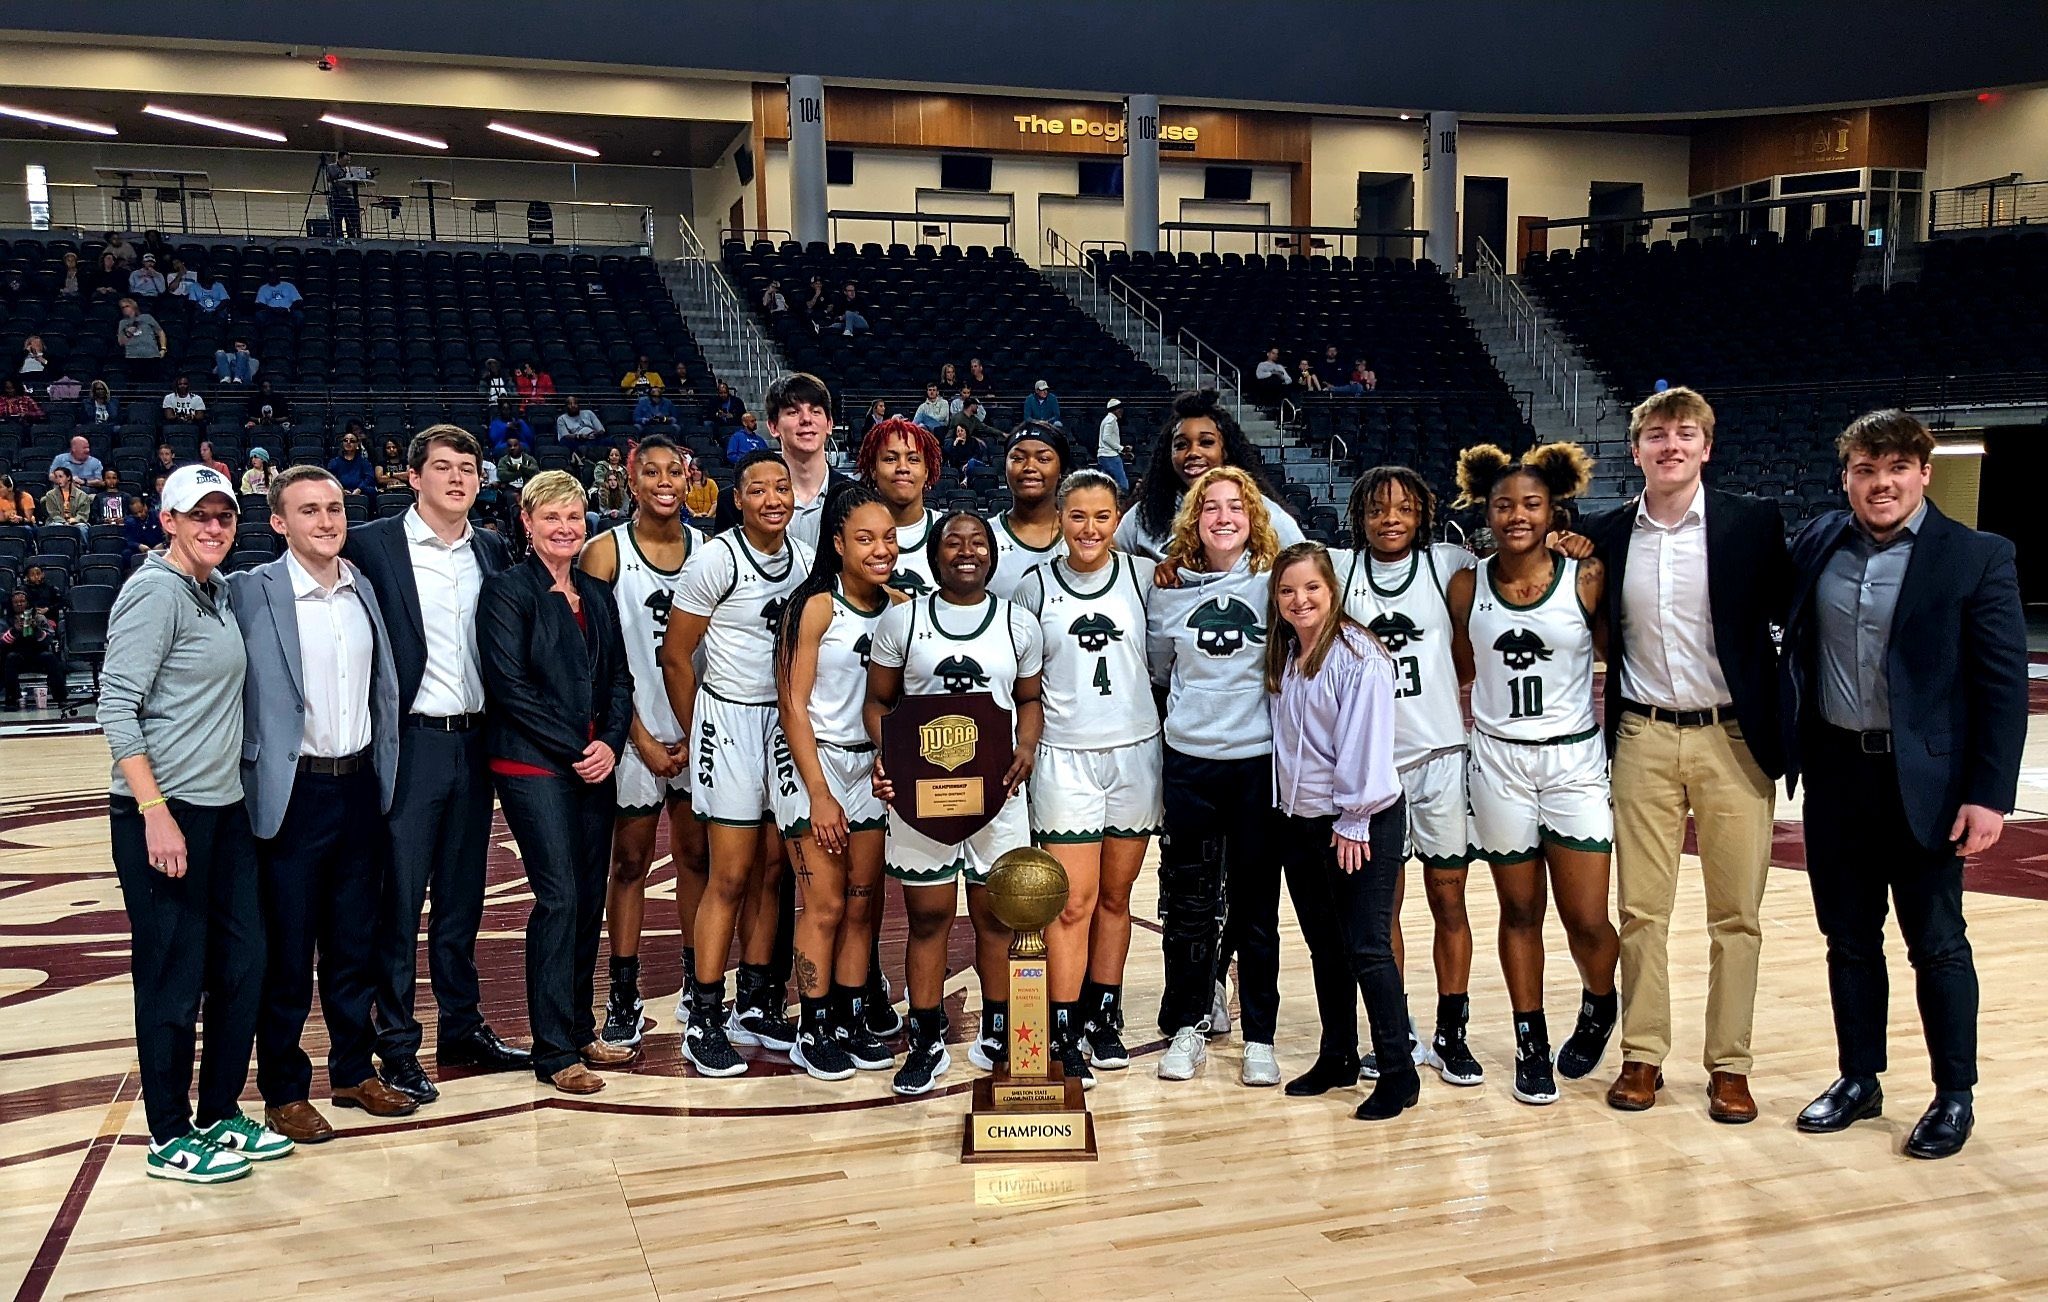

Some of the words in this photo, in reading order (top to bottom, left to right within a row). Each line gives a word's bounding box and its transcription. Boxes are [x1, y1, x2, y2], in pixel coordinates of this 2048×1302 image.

[799, 98, 820, 123] 104
[1014, 115, 1064, 134] The
[1071, 119, 1198, 141] Doguse
[1138, 116, 1157, 140] 105
[1093, 656, 1111, 695] 4
[1508, 675, 1543, 718] 10
[922, 724, 977, 755] NJCAA
[988, 1125, 1072, 1138] CHAMPIONS
